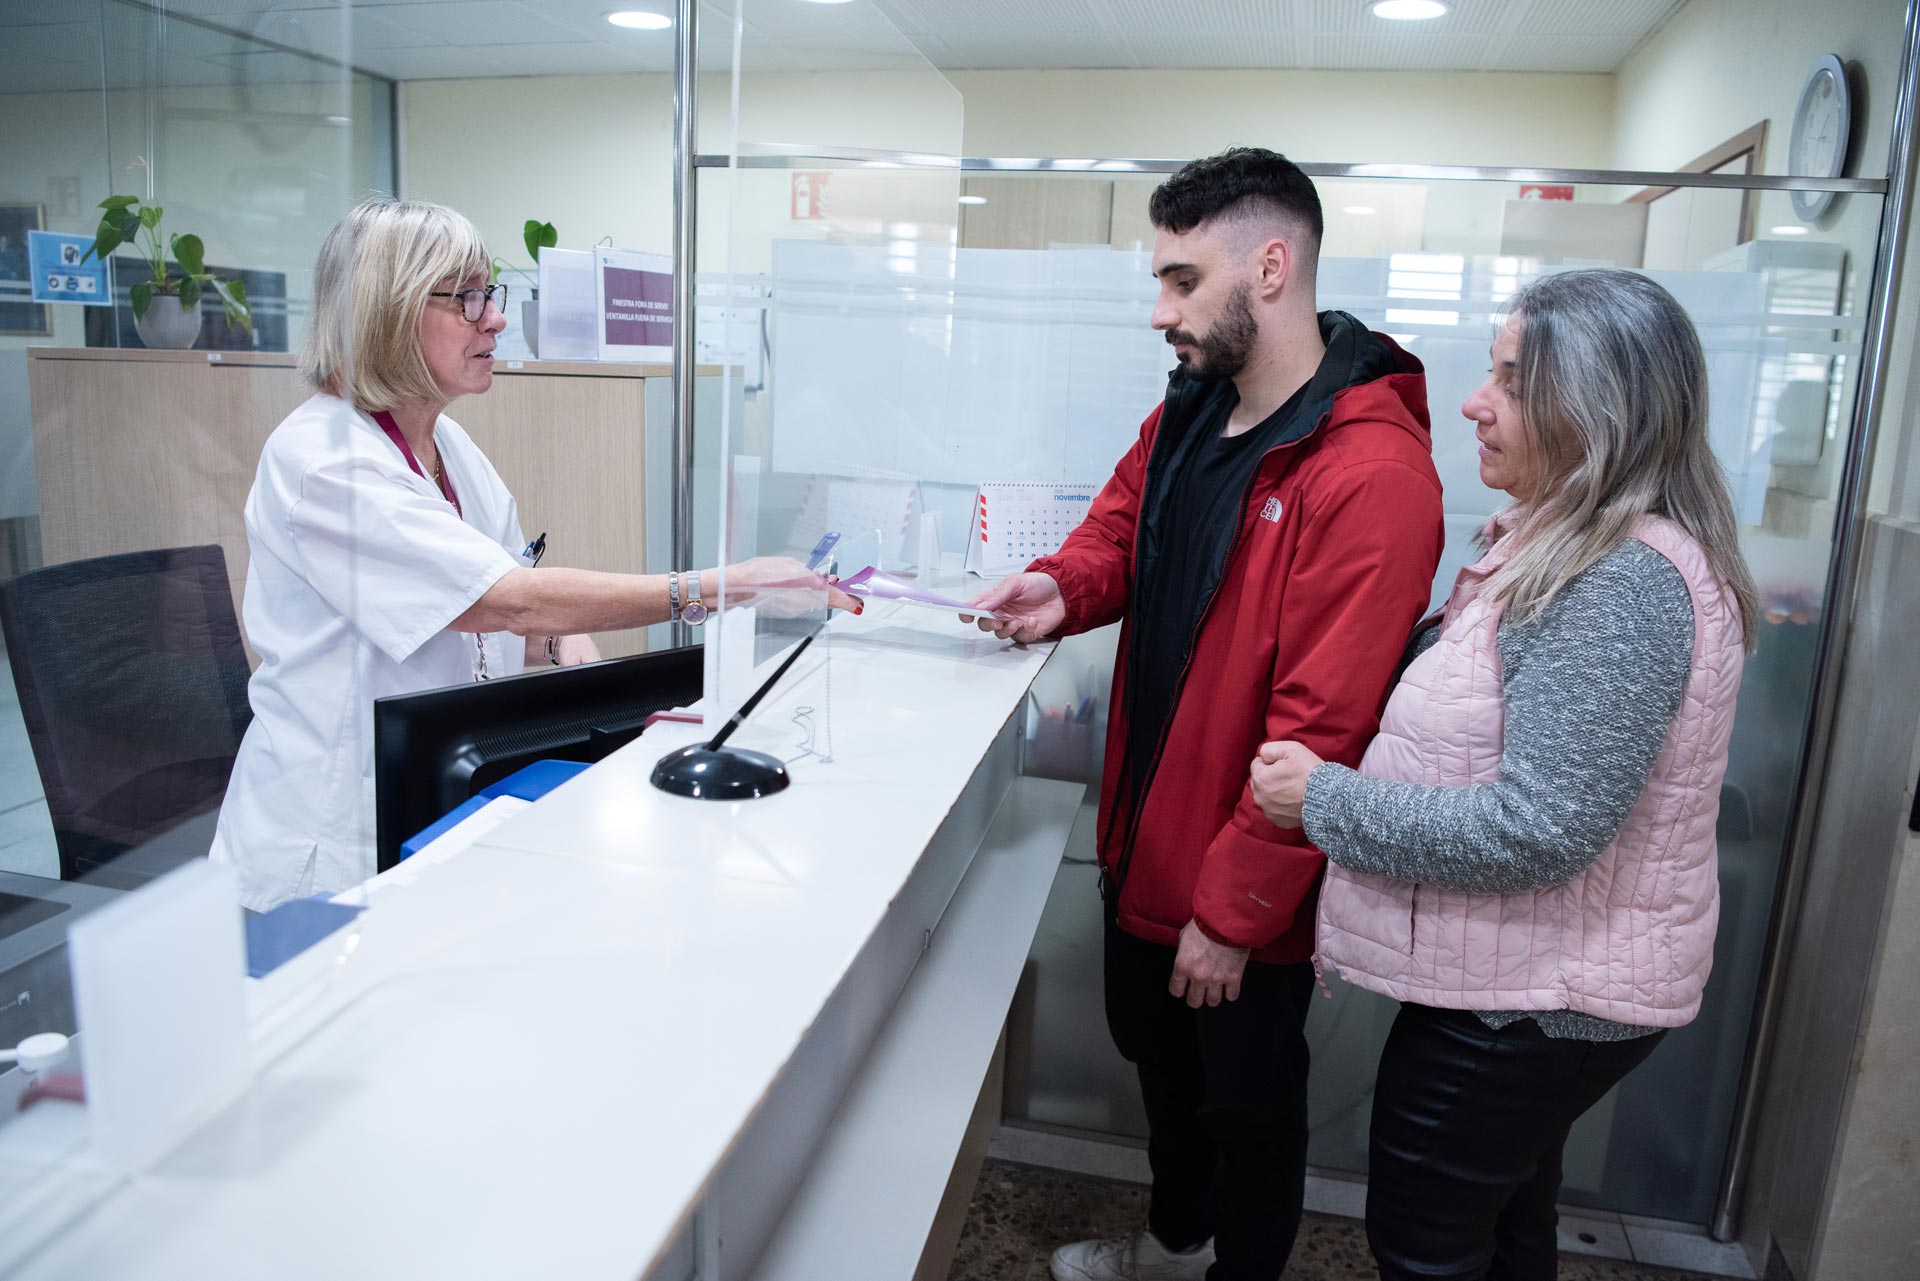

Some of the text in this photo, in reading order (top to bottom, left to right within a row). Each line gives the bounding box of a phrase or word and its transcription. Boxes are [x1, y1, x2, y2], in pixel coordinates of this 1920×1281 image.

[612, 299, 634, 307] FINESTRA
[635, 300, 647, 308] FORA
[606, 312, 634, 320] VENTANILLA
[635, 313, 648, 321] FUERA
